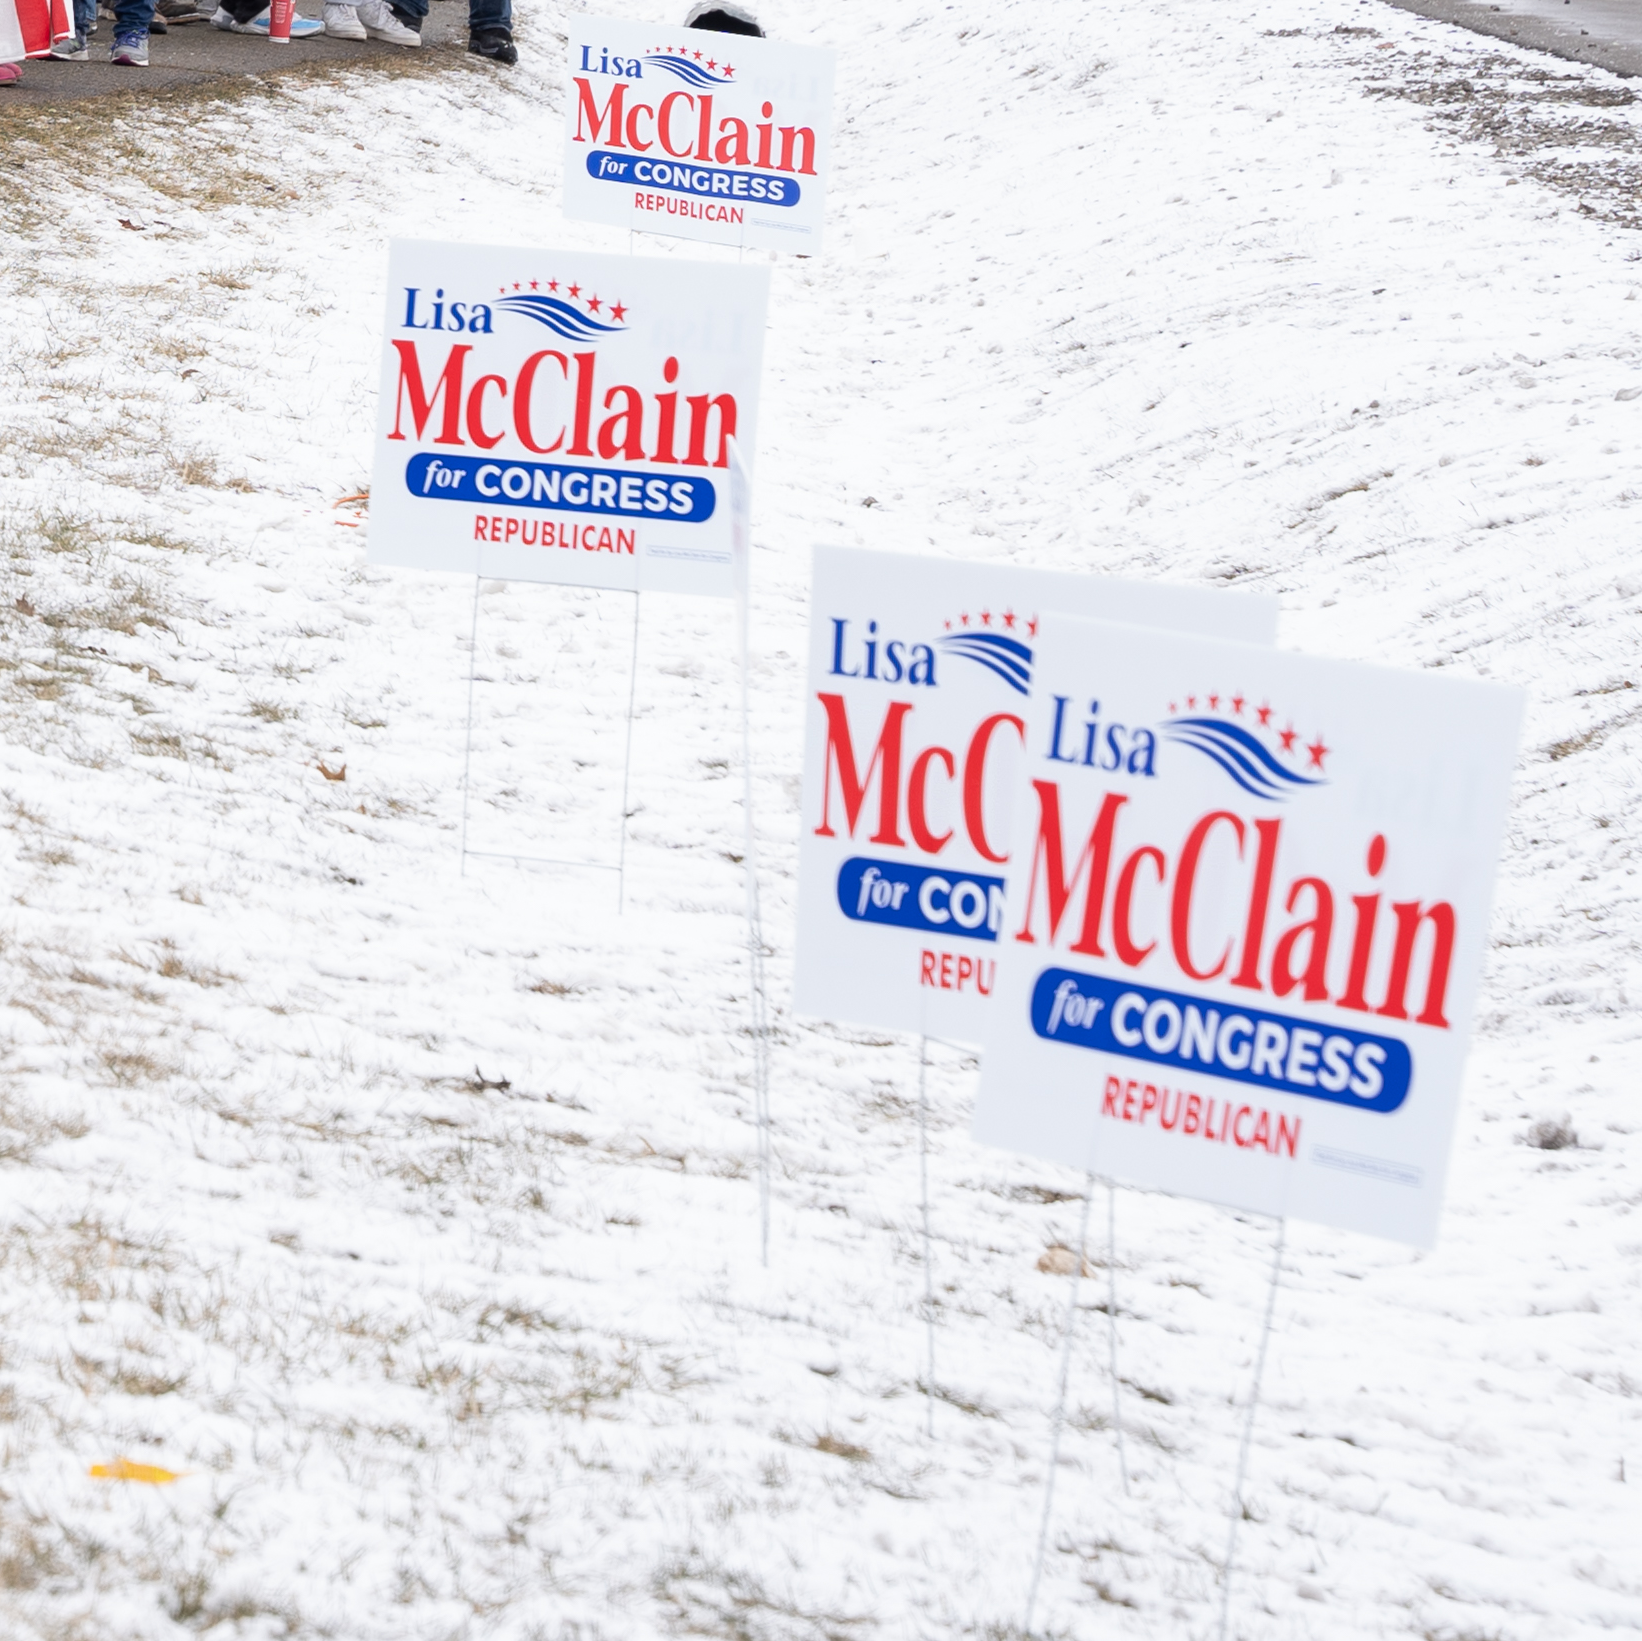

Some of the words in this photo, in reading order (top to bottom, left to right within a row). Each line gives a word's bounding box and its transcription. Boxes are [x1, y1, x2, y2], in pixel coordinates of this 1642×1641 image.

[579, 45, 643, 79] Lisa
[572, 77, 818, 176] McClain
[599, 155, 628, 177] for
[634, 161, 785, 201] CONGRESS
[635, 192, 744, 225] REPUBLICAN
[401, 286, 494, 334] Lisa
[387, 338, 738, 468] McClain
[423, 459, 466, 494] for
[474, 463, 695, 515] CONGRESS
[474, 514, 636, 555] REPUBLICAN
[828, 616, 939, 687] Lisa
[1046, 694, 1159, 778] Lisa
[857, 866, 910, 917] for
[1015, 778, 1457, 1031] McClain
[1046, 978, 1104, 1035] for
[1110, 992, 1388, 1100] CONGRESS
[1101, 1073, 1303, 1159] REPUBLICAN
